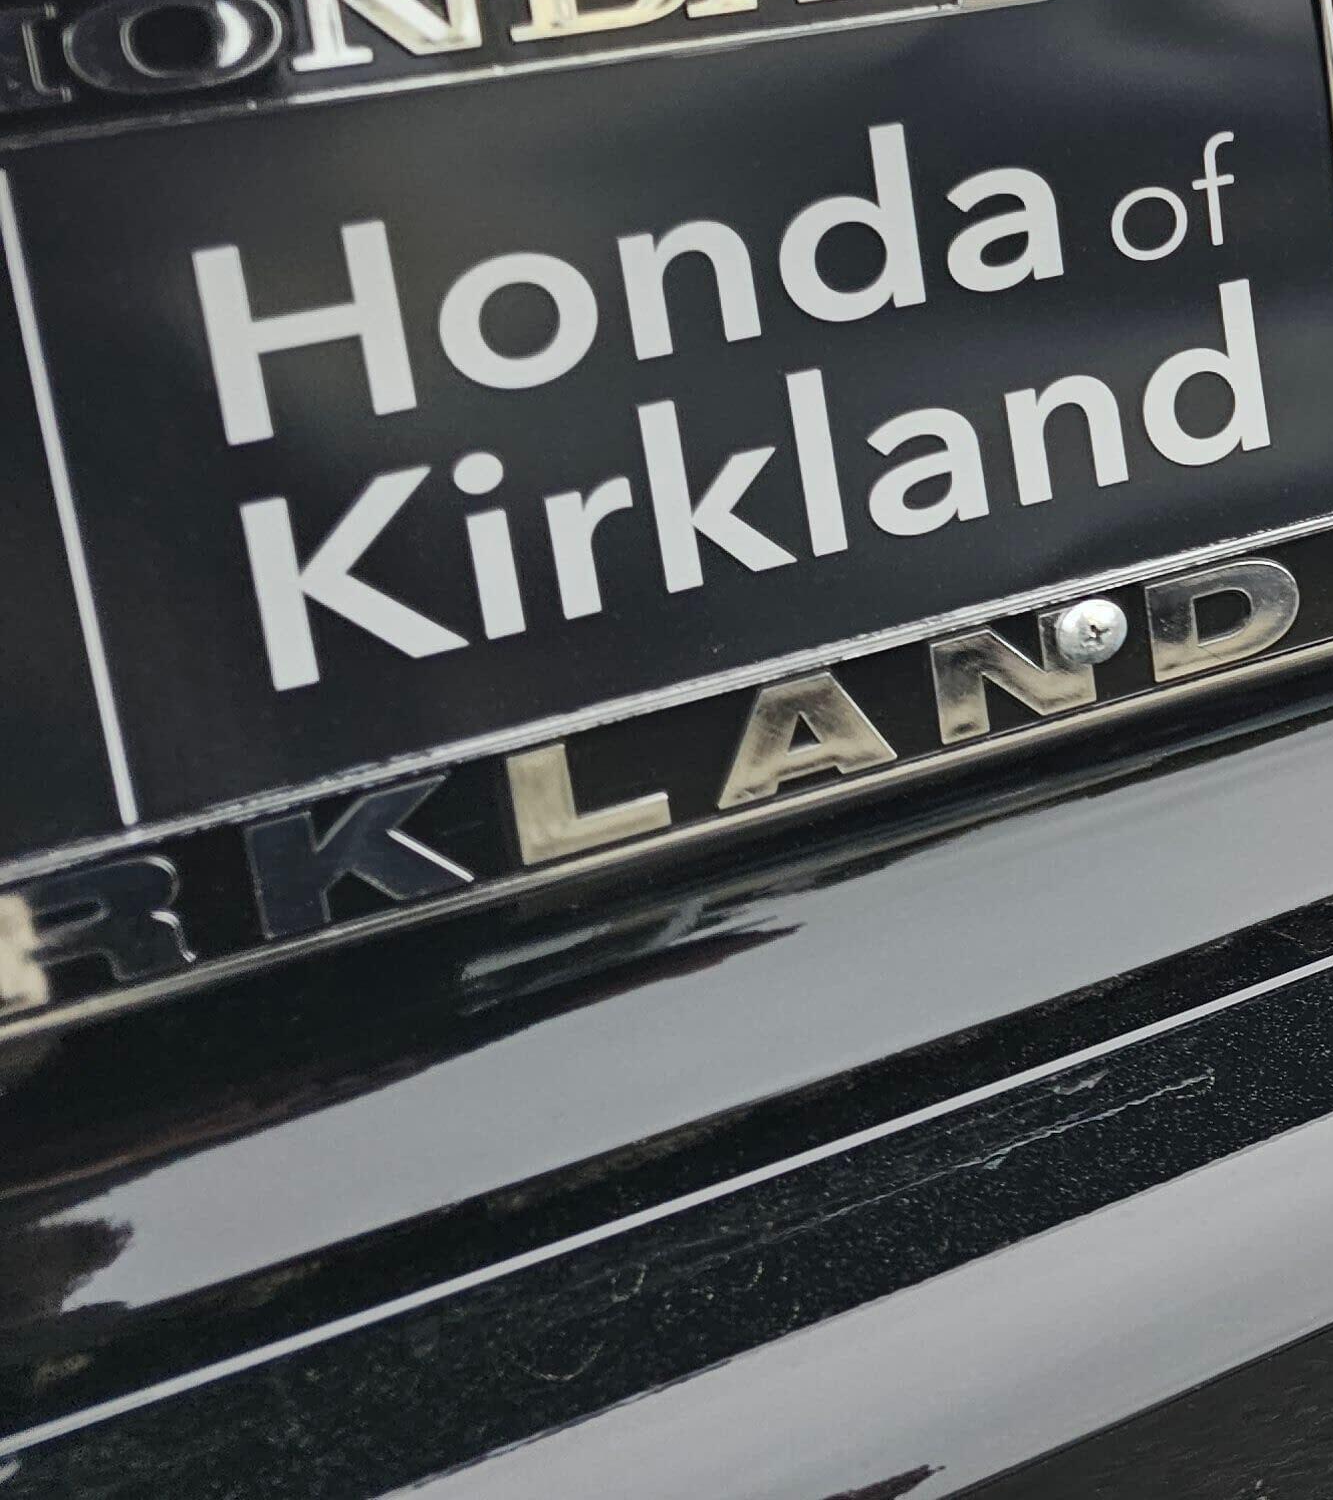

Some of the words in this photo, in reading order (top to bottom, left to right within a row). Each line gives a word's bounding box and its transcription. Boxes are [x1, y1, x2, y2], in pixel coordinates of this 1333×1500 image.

[192, 122, 1064, 446] Honda
[1111, 131, 1235, 262] of
[240, 279, 1271, 692] Kirkland
